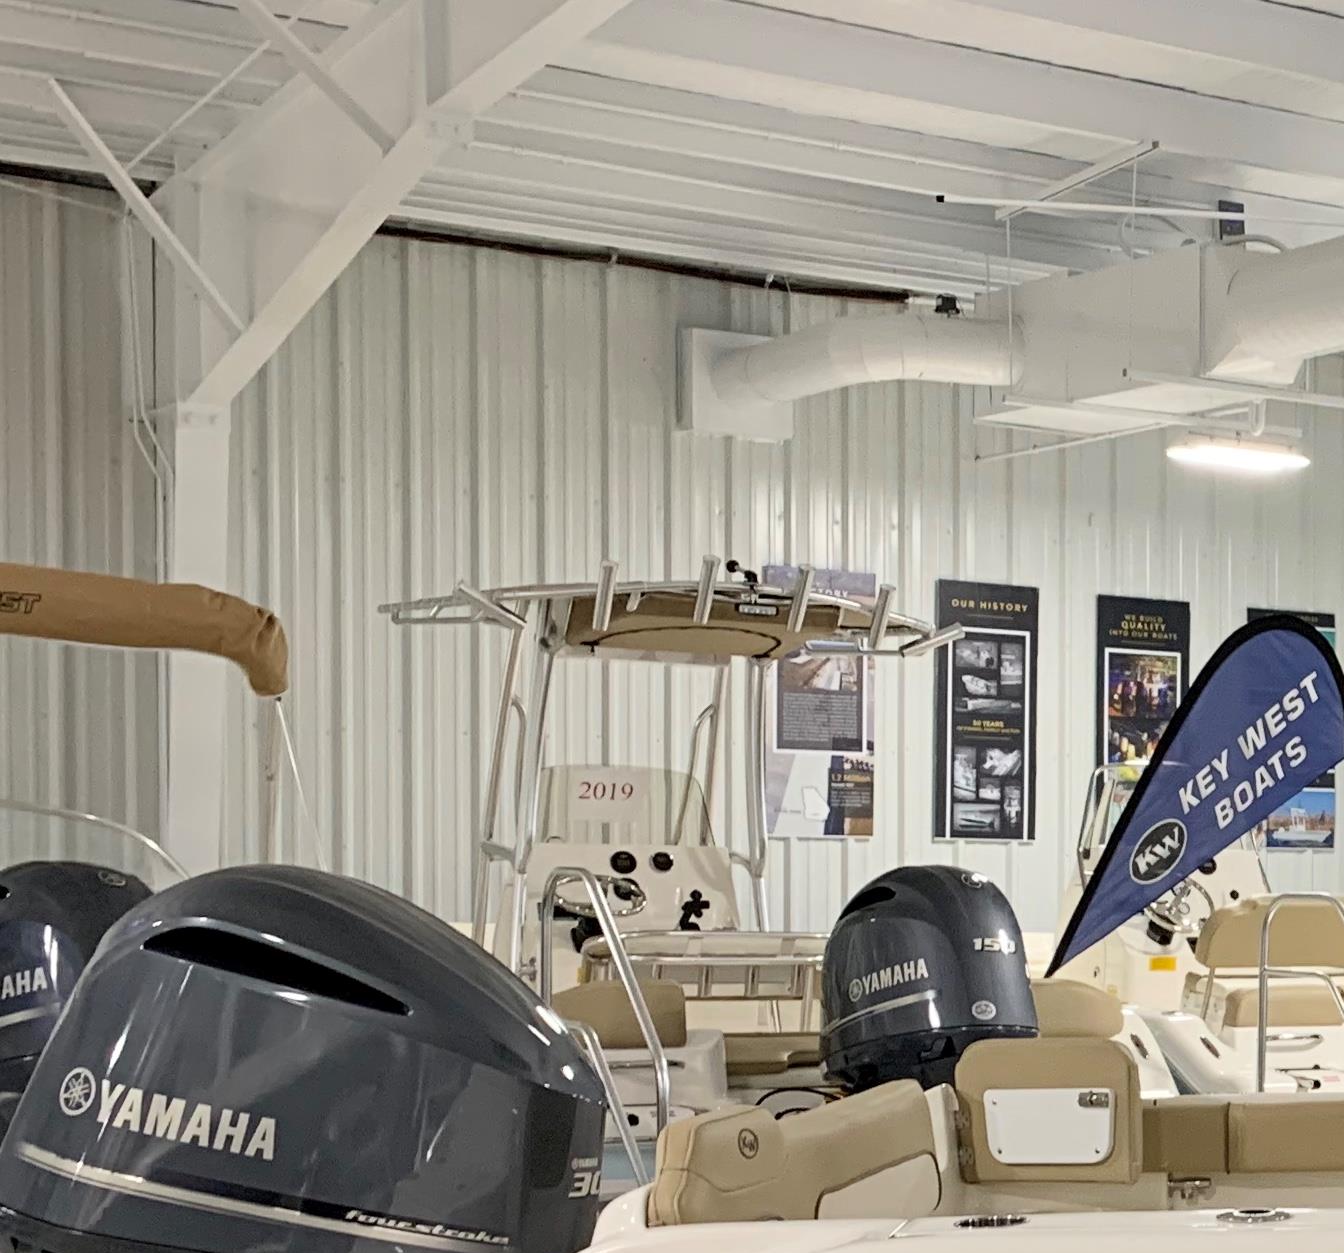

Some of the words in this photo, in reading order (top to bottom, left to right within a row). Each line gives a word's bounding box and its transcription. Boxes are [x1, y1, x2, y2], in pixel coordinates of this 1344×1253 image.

[951, 598, 975, 608] OUR
[980, 601, 1028, 612] HISTORY
[1121, 620, 1166, 632] QUALITY
[1178, 748, 1230, 815] KEY
[1237, 671, 1320, 760] WEST
[579, 781, 634, 801] 2019
[1214, 736, 1307, 830] BOATS
[1135, 826, 1181, 875] KW
[0, 966, 48, 1000] AHA
[862, 958, 929, 995] YAMAHA
[97, 1079, 277, 1162] YAMAHA
